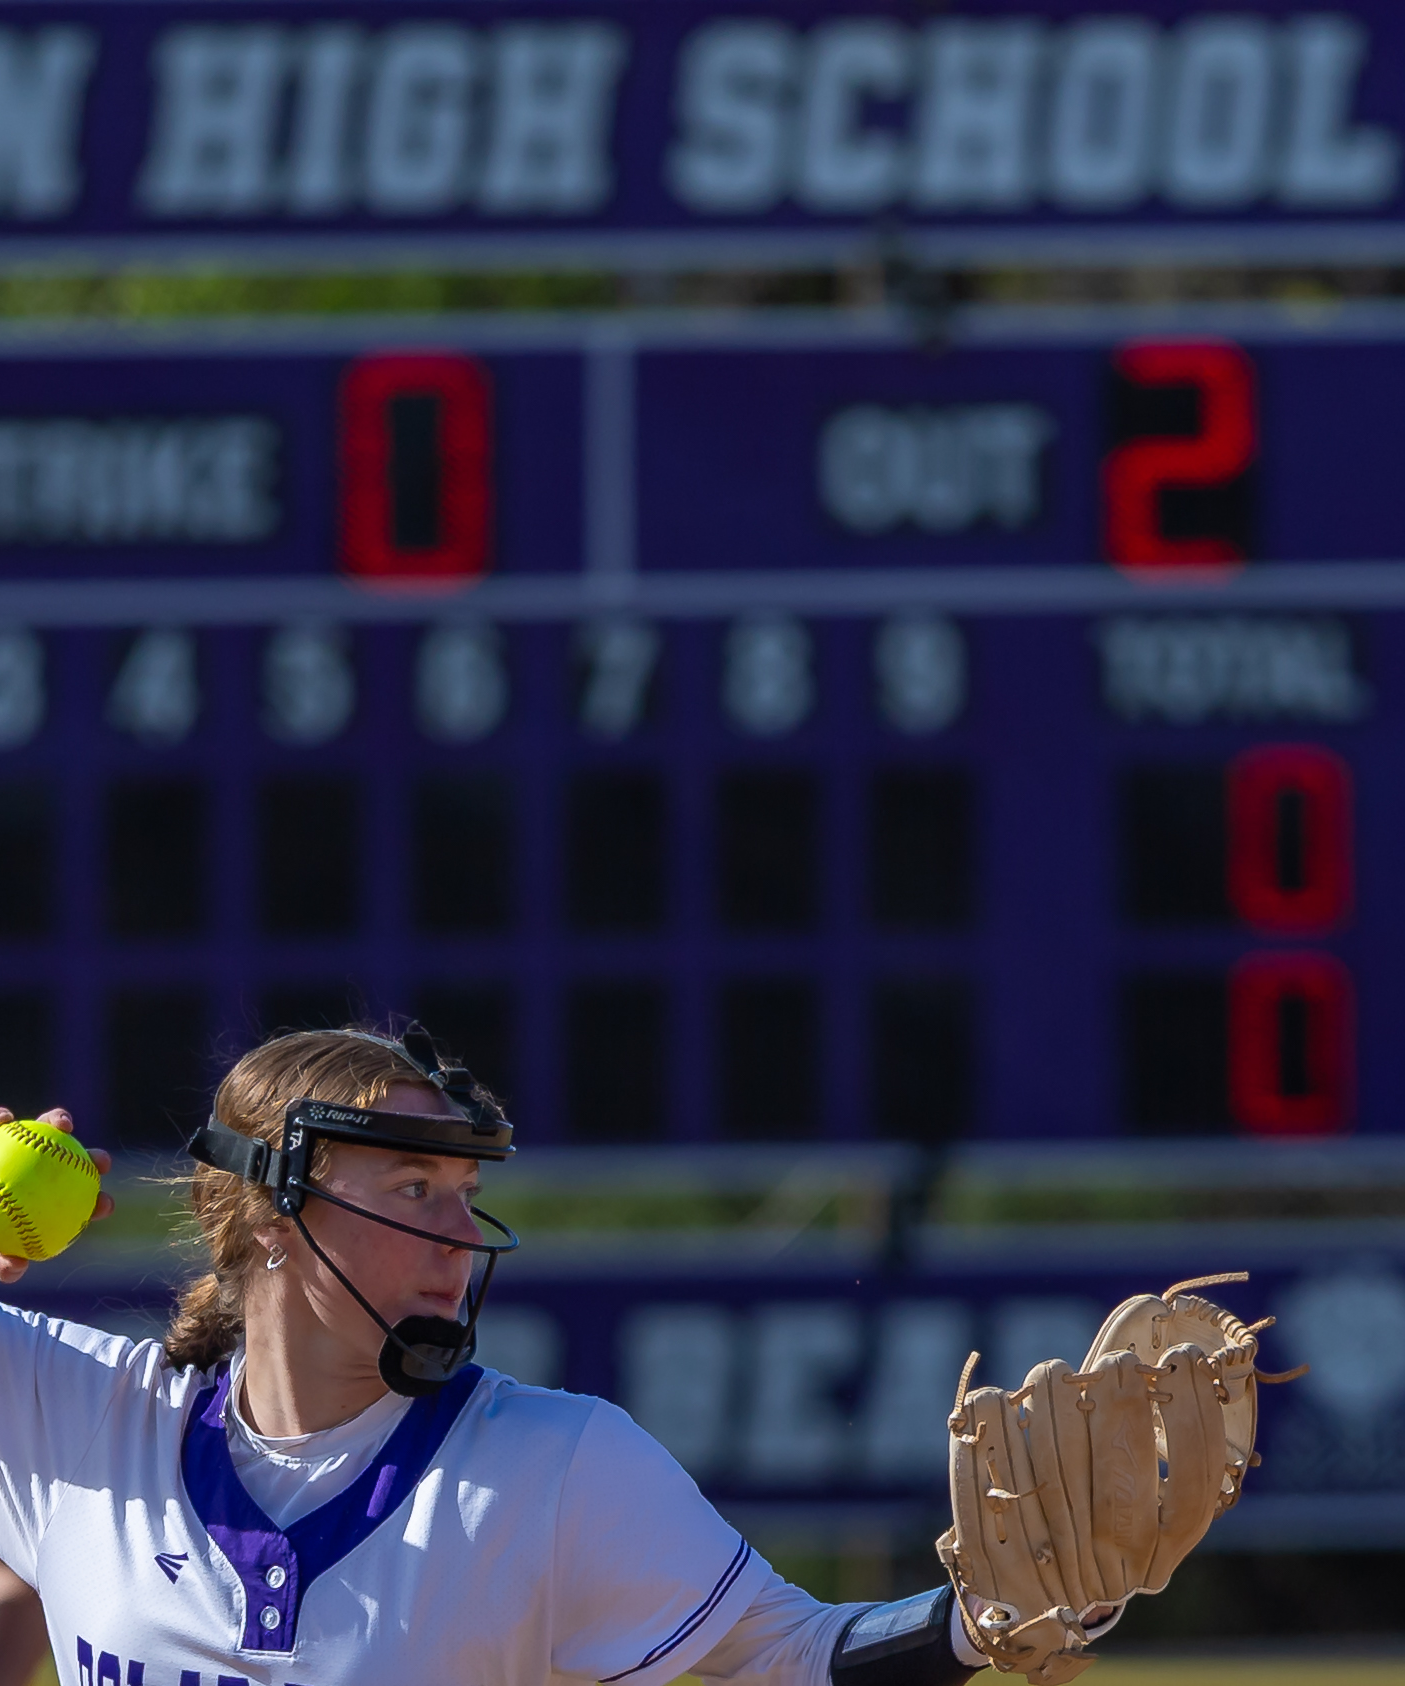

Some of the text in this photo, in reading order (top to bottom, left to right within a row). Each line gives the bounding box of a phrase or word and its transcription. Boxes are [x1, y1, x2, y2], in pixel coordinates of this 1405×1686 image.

[139, 24, 625, 214] HIGH
[668, 16, 1399, 212] SCHOOL
[338, 348, 495, 595] 0
[818, 402, 1049, 531] OUT
[1101, 337, 1258, 584] 2
[113, 628, 197, 740] 4
[265, 626, 354, 743] 5
[417, 626, 505, 740] 6
[579, 622, 659, 737] 7
[726, 618, 811, 734] 8
[875, 618, 964, 732] 9
[1098, 618, 1363, 722] TOTAL
[1227, 742, 1355, 940] 0
[326, 1109, 371, 1125] RIP-IT
[1227, 947, 1356, 1143] 0
